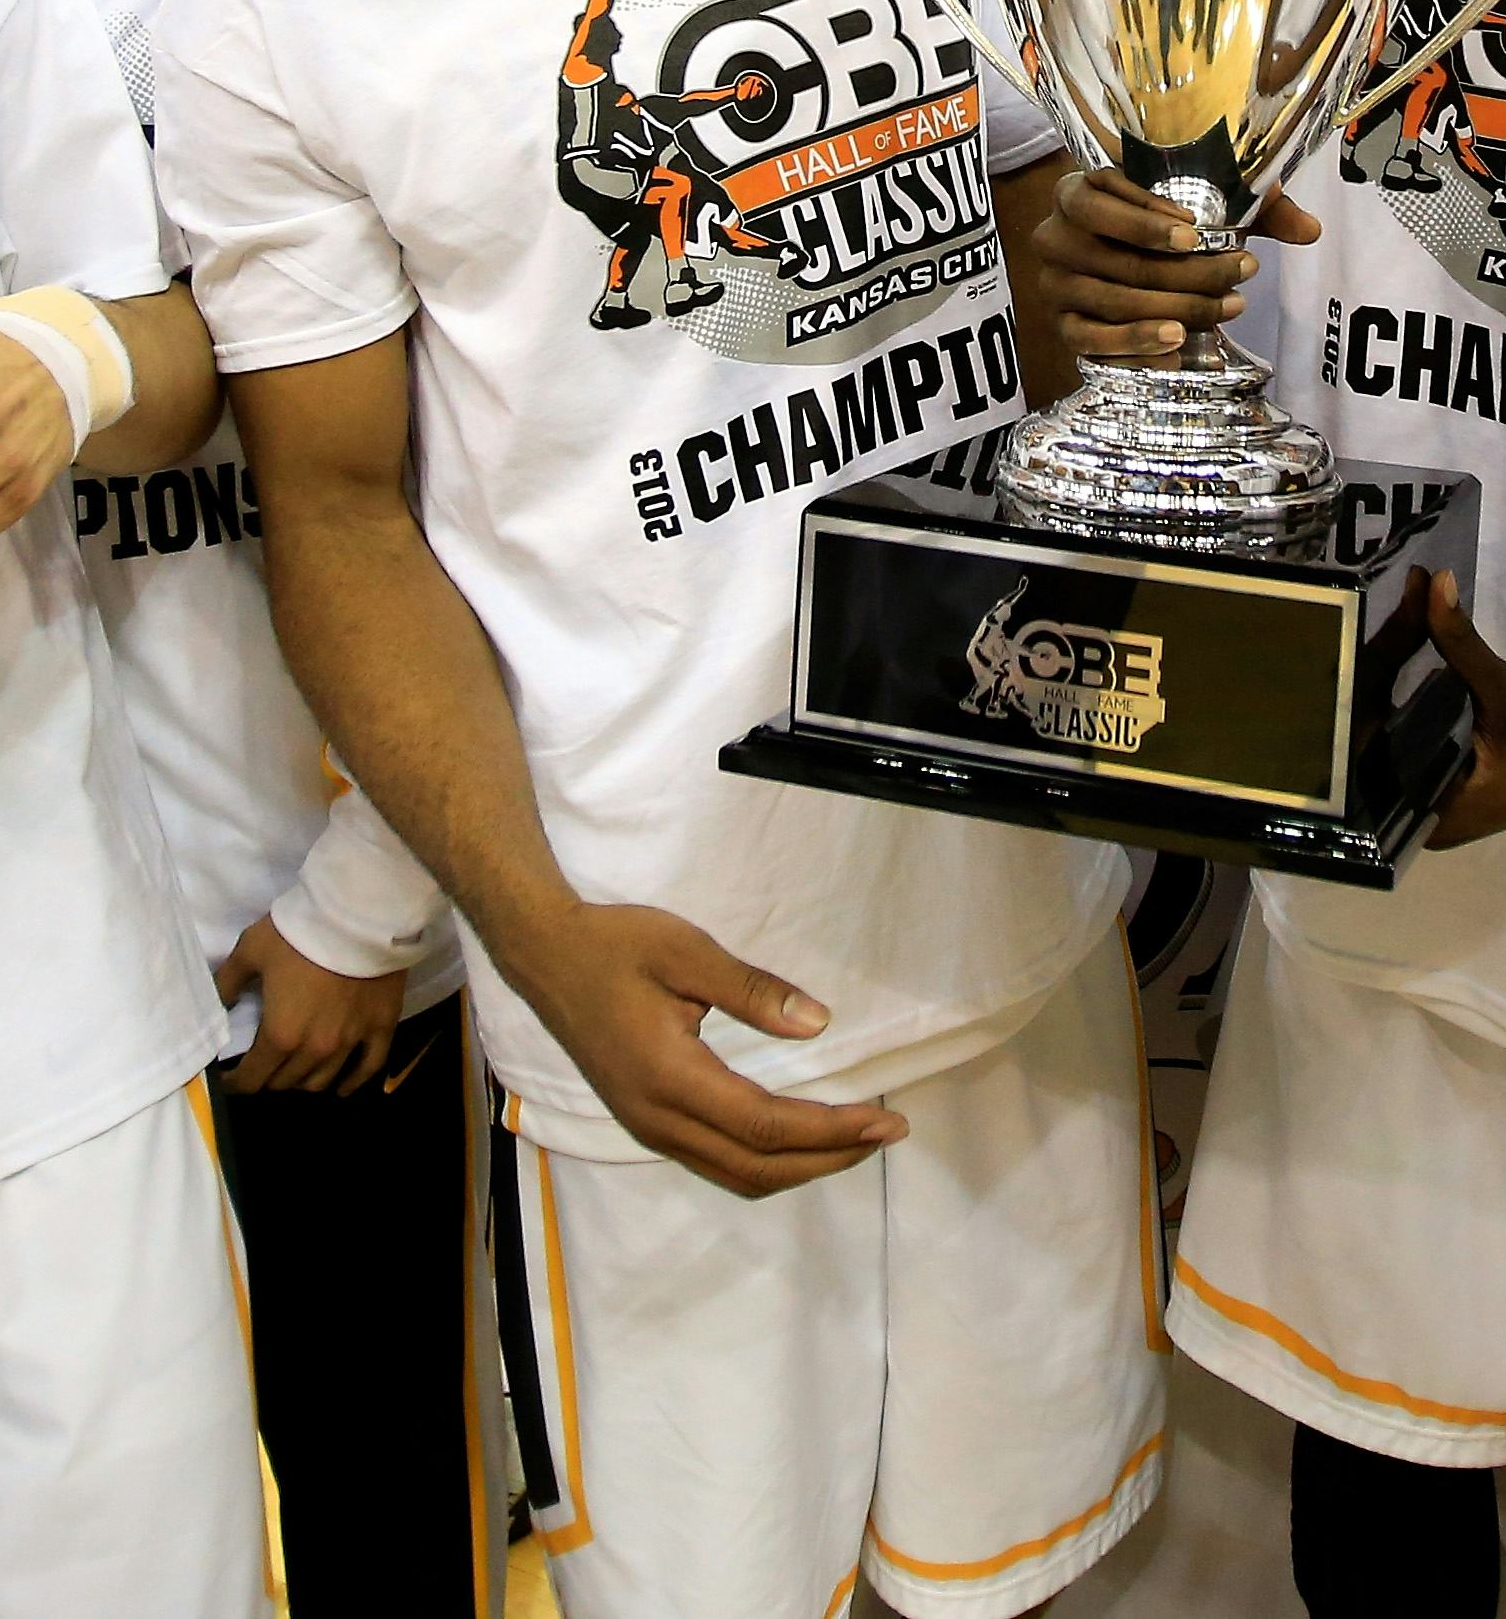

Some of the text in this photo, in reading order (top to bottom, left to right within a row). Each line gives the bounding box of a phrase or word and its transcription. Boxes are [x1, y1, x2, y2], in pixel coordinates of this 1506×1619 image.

[777, 95, 969, 192] HALL OF FAME
[779, 137, 992, 283] CLASSIC
[792, 236, 998, 339] KANSAS CITY
[1321, 297, 1342, 389] 2013
[677, 307, 1017, 524] CHAMPIO
[629, 448, 684, 543] 2013
[1019, 630, 1153, 696] CBE
[1044, 686, 1079, 705] HALL
[1098, 694, 1134, 713] FAME
[1038, 701, 1139, 748] CLASSIC
